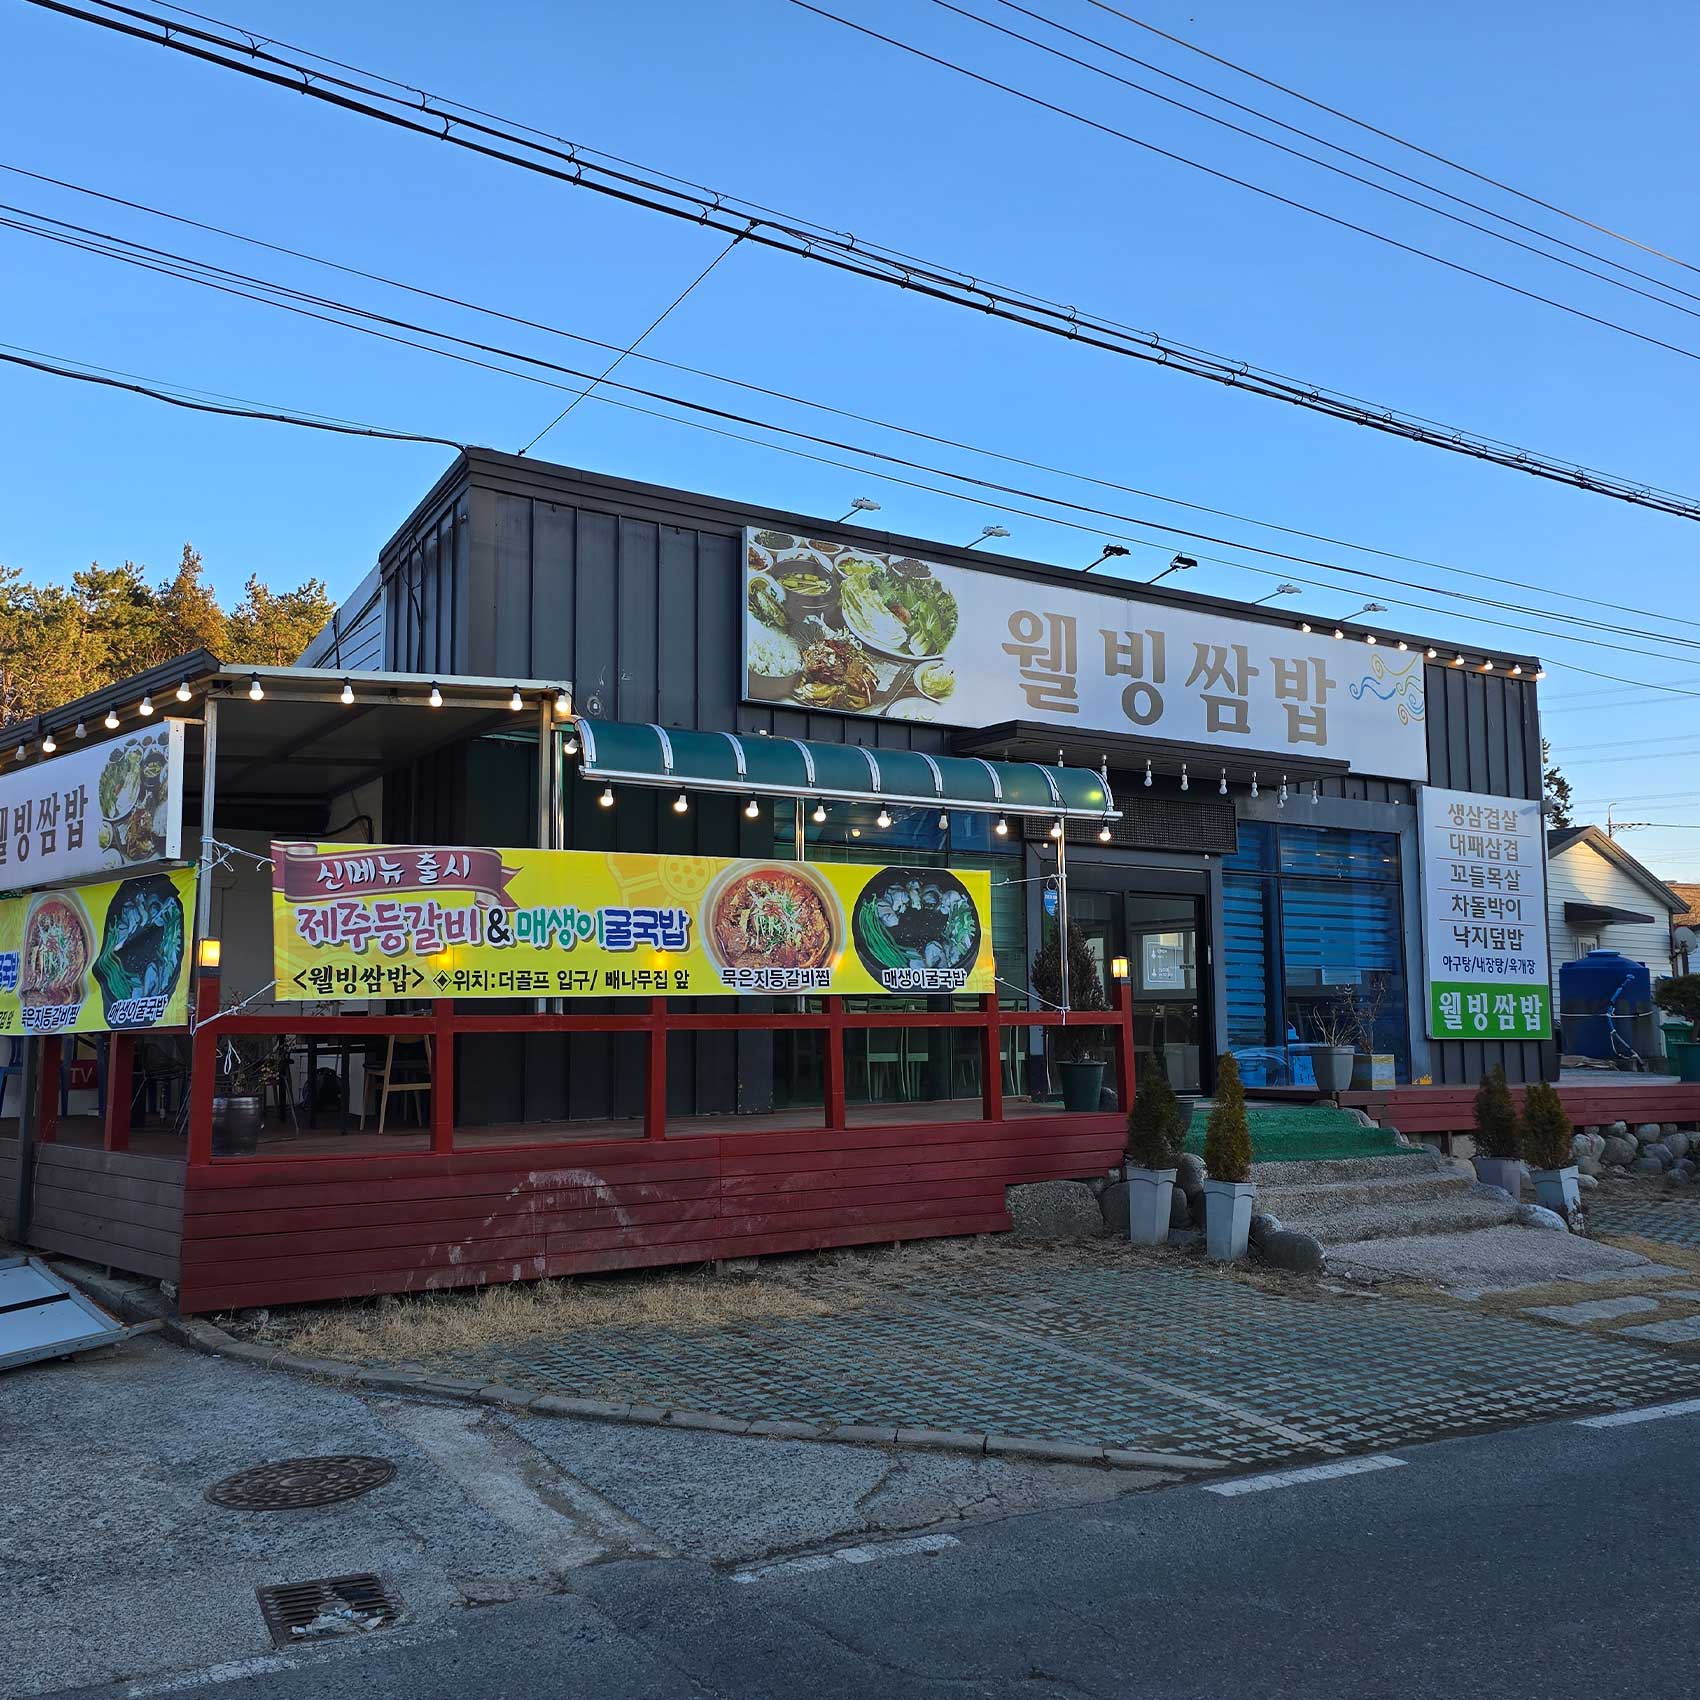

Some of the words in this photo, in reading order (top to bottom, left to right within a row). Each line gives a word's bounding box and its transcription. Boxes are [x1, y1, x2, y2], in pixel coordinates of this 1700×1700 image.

[1001, 609, 1337, 746] 웰빙쌈밥
[1447, 803, 1519, 833] 생삼겹살
[1449, 833, 1519, 862] 대패삼겹
[316, 855, 405, 891] 신메뉴
[416, 852, 472, 885] 출시
[1450, 864, 1521, 892] 꼬들목살
[1451, 894, 1522, 921] 차돌박이
[1453, 925, 1524, 951] 낙지덮밥
[292, 963, 425, 995] <웰빙쌈밥>
[604, 969, 669, 991] 배나무집
[673, 969, 690, 990] 앞
[720, 967, 831, 989] 묵은지등갈비찜
[882, 968, 967, 989] 매생이굴국밥
[1439, 991, 1543, 1031] 웰빙쌈밥
[70, 1066, 94, 1084] TV
